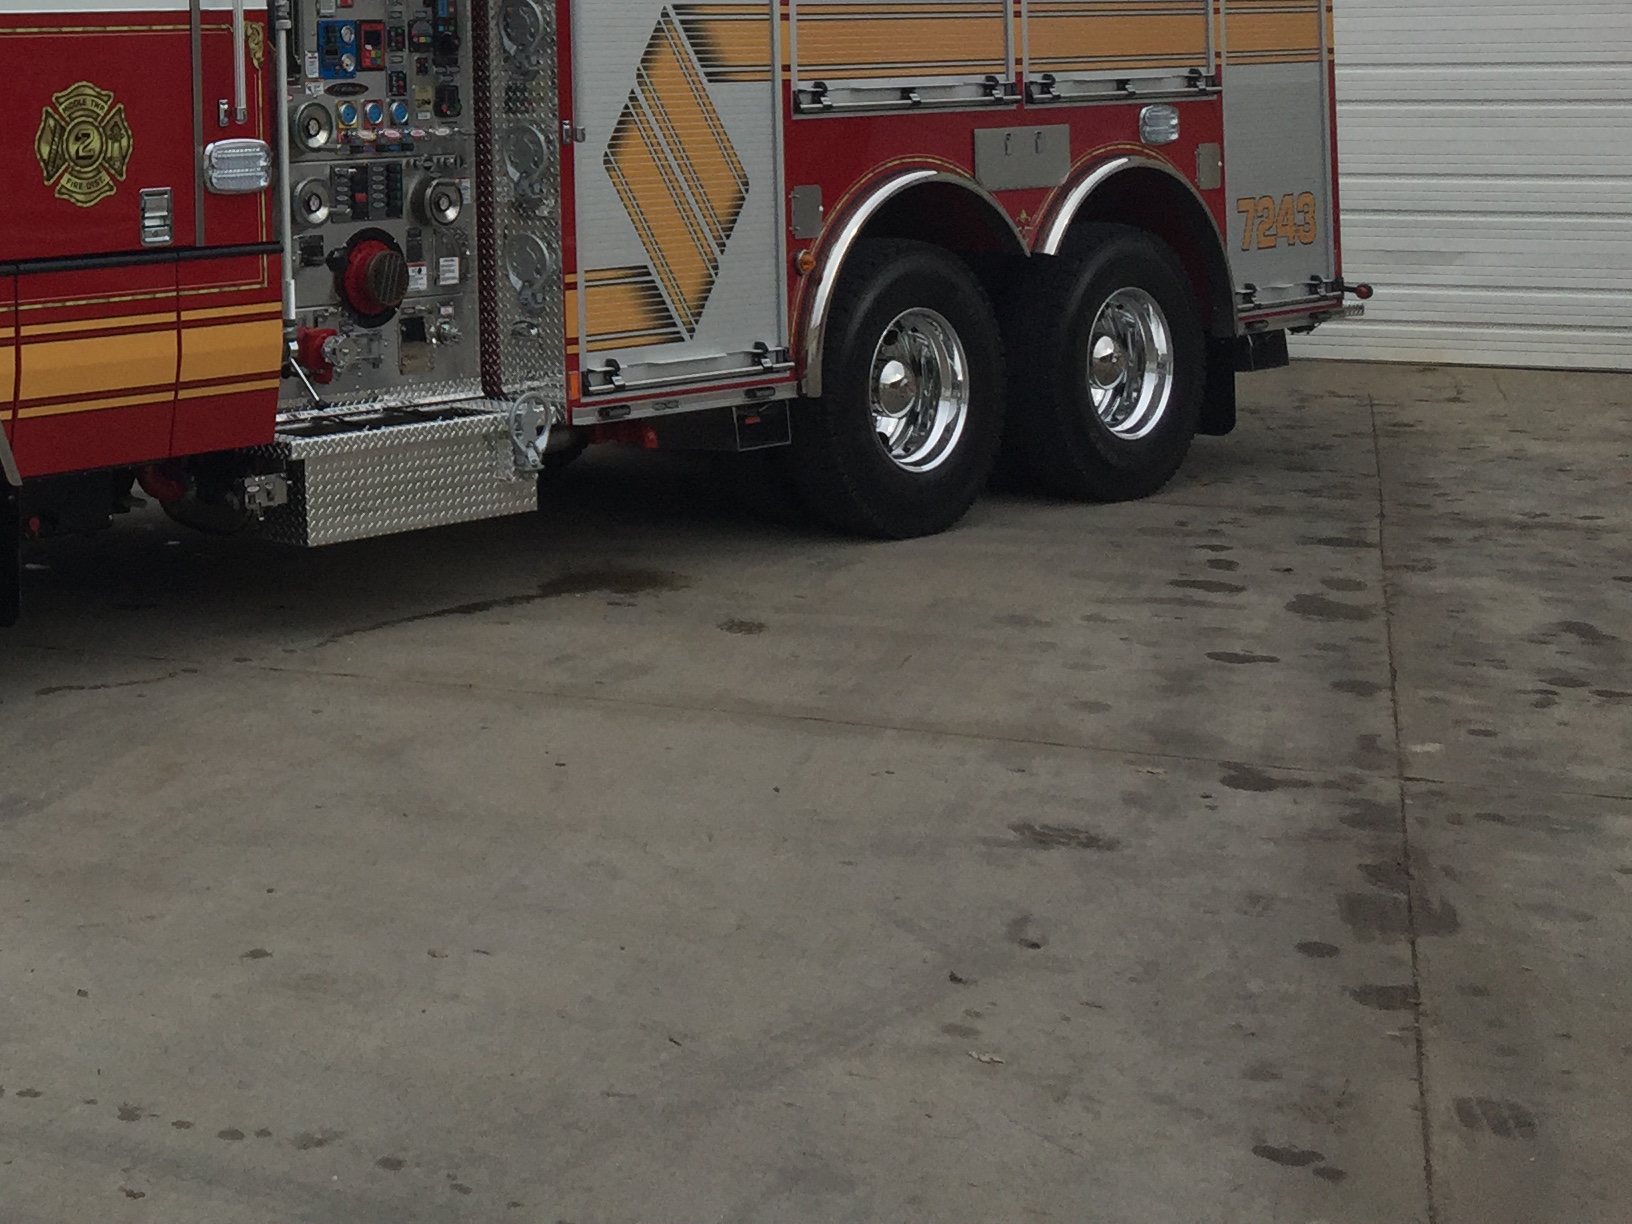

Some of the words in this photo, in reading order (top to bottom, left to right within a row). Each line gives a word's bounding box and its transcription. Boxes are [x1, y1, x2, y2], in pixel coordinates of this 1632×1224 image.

[73, 128, 96, 161] 2
[65, 177, 84, 190] FIRE
[1236, 190, 1318, 251] 7243
